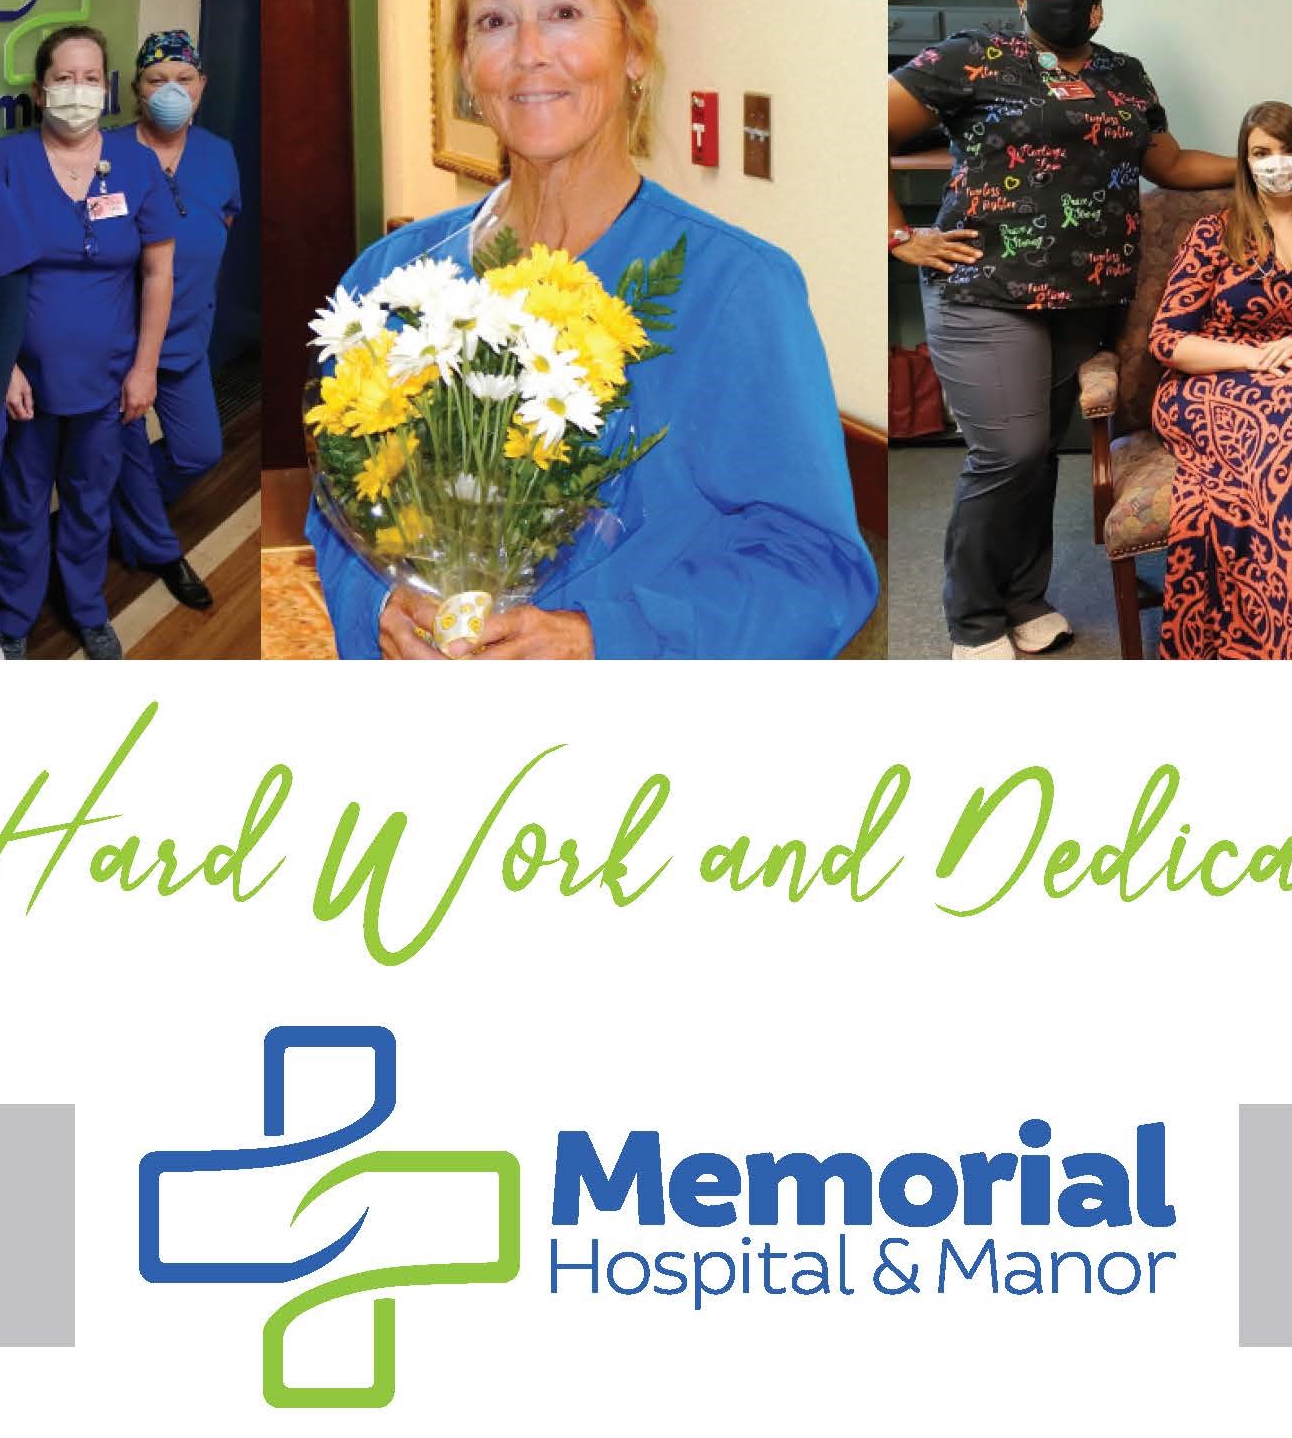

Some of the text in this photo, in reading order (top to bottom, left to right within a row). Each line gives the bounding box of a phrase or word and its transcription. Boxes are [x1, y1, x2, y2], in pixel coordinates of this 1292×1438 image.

[313, 744, 673, 966] Work
[700, 764, 912, 903] and
[552, 1118, 1177, 1228] Memorial
[551, 1234, 1177, 1311] Hospital & Manor
